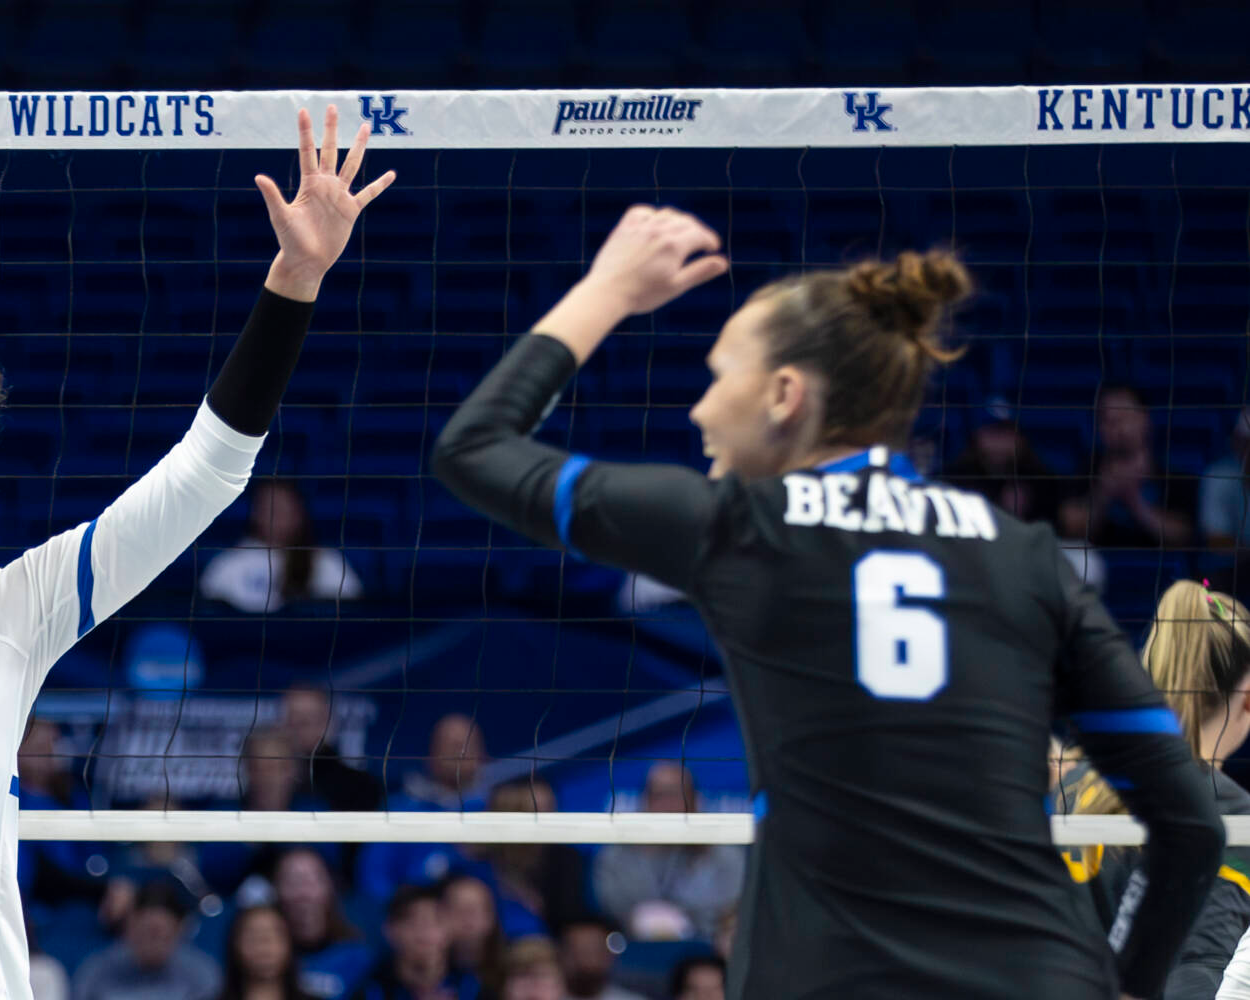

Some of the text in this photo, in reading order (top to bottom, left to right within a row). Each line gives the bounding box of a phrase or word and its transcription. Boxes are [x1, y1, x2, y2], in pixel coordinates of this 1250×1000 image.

[7, 94, 215, 137] WILDCATS
[358, 95, 409, 136] UK
[552, 94, 703, 135] paul miller
[569, 127, 684, 135] MOTOR COMPANY
[842, 92, 893, 132] UK
[783, 471, 997, 541] BEAVIN
[853, 548, 949, 702] 6
